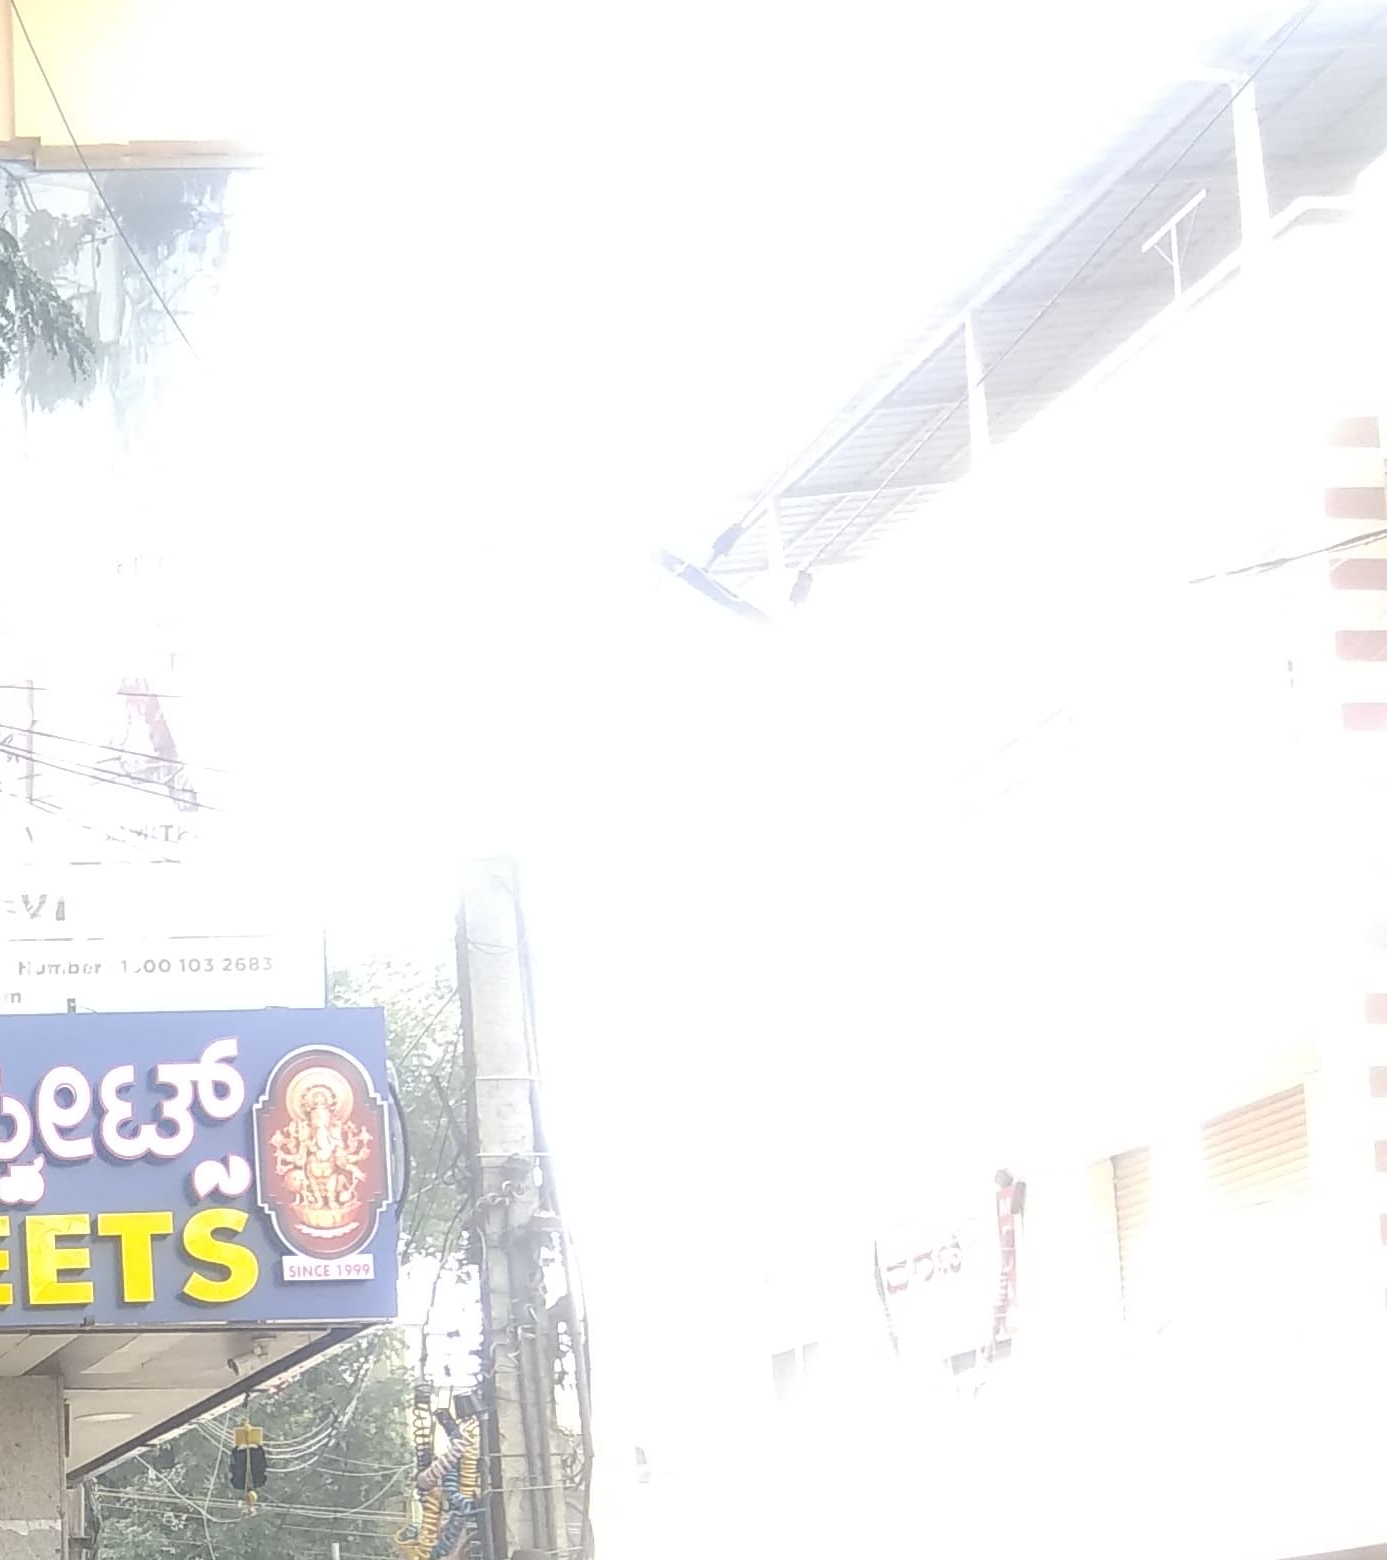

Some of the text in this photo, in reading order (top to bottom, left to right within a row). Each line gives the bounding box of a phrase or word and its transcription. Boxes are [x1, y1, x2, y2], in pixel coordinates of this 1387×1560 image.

[121, 958, 172, 974] 100
[178, 957, 215, 973] 103
[221, 956, 274, 972] 2683
[288, 1263, 371, 1278] SINCE 1999
